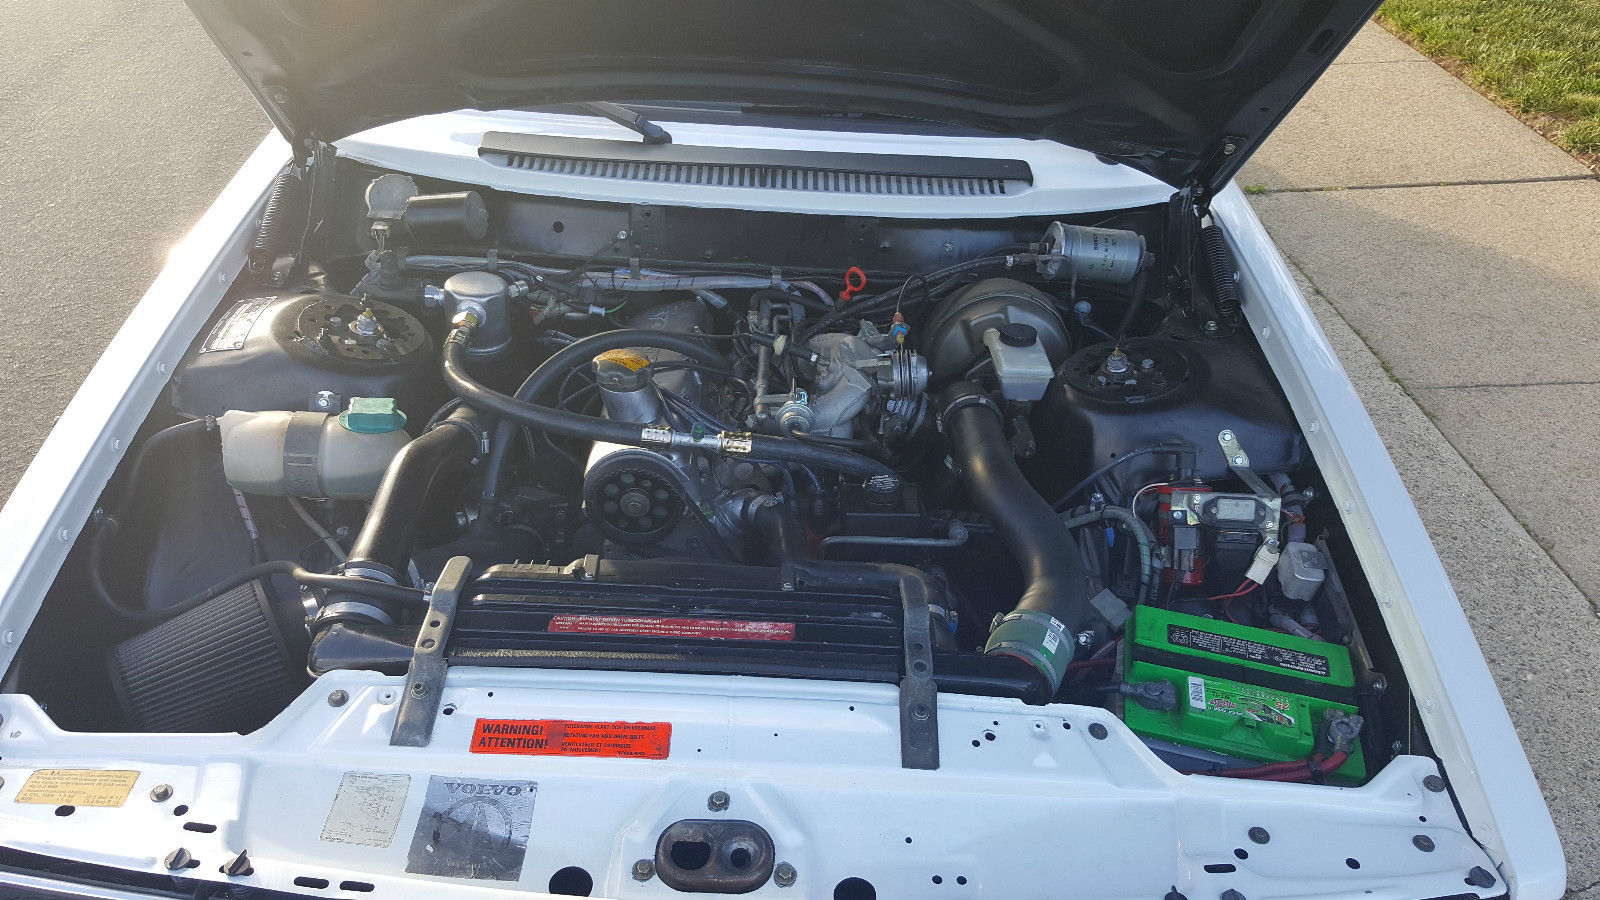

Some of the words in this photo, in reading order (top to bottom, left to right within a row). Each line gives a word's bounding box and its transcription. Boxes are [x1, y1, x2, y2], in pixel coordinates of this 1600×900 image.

[482, 723, 544, 736] WARNING!
[478, 736, 549, 749] ATTENTION!
[444, 782, 522, 796] VOLVO
